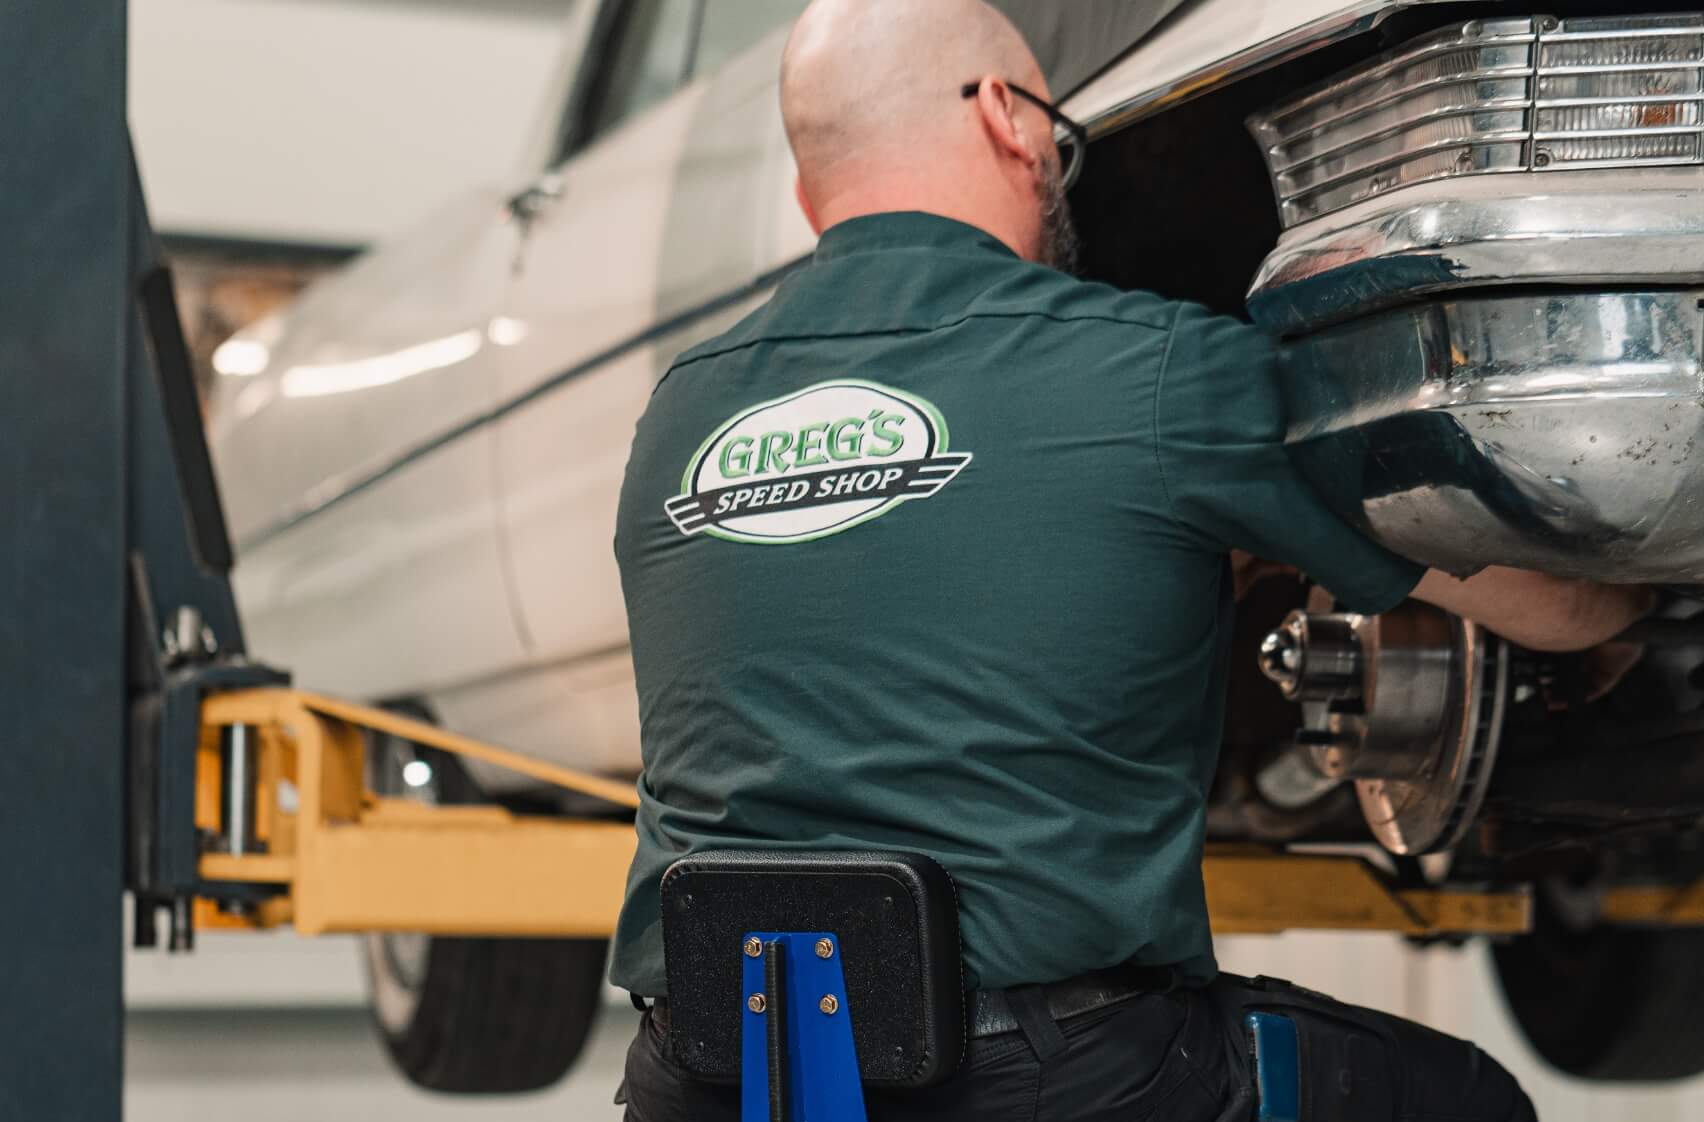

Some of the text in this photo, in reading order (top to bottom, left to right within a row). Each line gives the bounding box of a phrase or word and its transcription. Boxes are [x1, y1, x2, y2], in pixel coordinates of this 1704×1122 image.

[719, 410, 905, 478] GREG'S
[714, 469, 903, 515] SPEED SHOP
